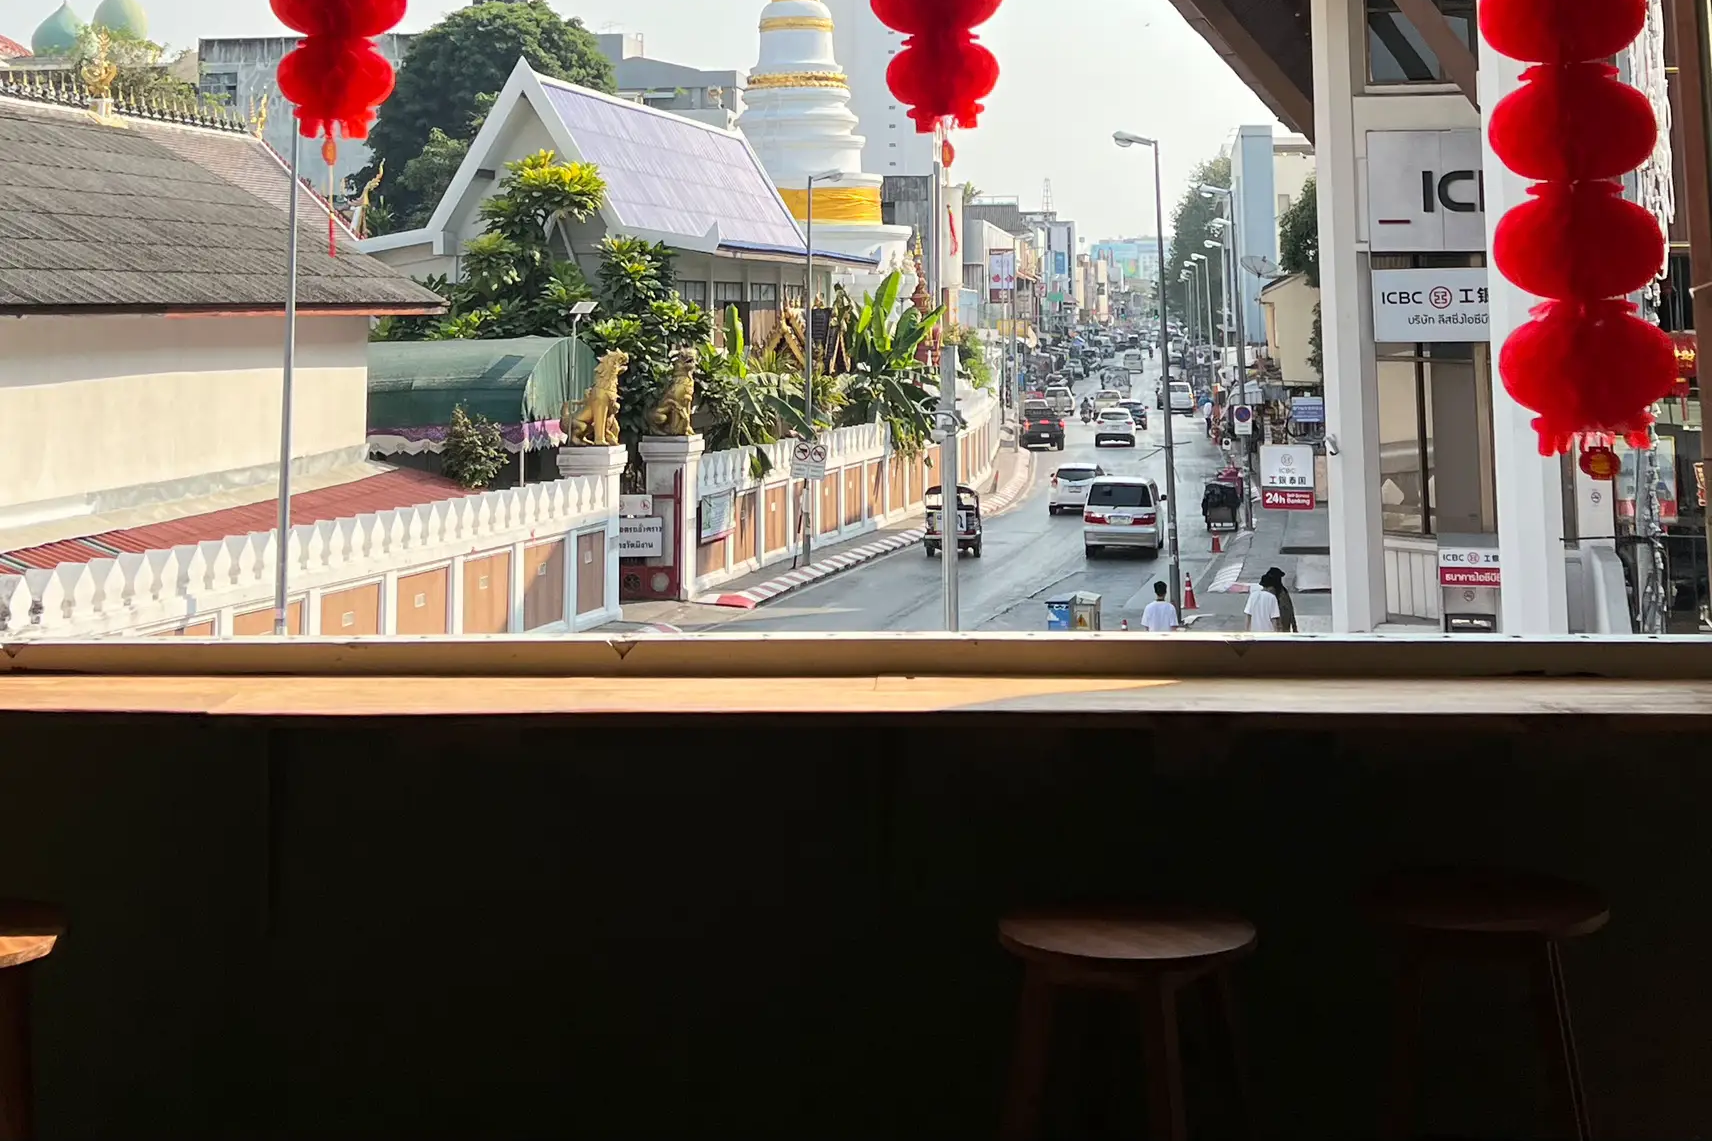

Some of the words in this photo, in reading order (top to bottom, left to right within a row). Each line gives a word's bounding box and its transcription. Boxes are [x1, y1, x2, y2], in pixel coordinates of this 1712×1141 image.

[1382, 291, 1423, 305] ICBC
[1407, 314, 1435, 325] บริษัท
[1265, 492, 1286, 504] 24h
[1443, 553, 1465, 562] ICBC
